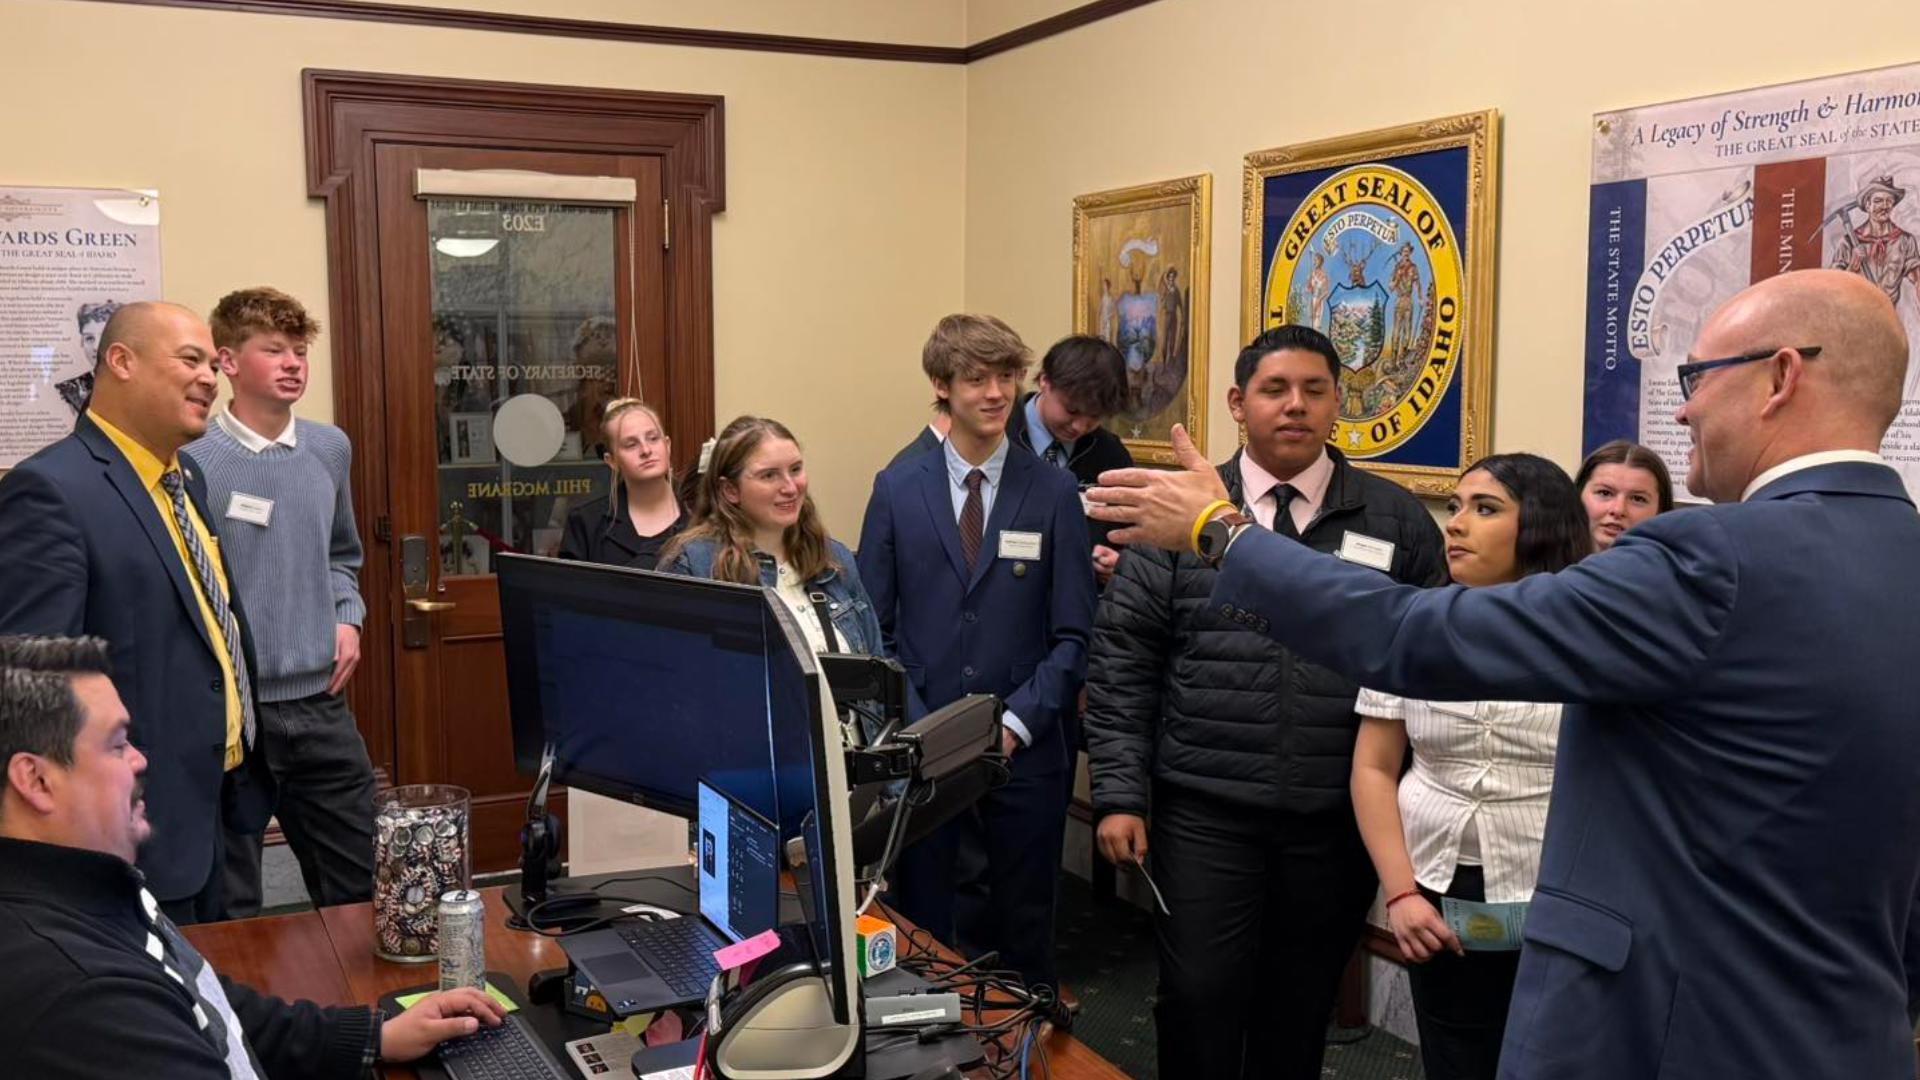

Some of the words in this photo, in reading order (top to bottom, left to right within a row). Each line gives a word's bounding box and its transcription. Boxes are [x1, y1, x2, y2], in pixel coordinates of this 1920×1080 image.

[1630, 126, 1645, 146] A
[1650, 123, 1705, 148] Legacy
[1711, 109, 1731, 141] of
[1732, 99, 1809, 133] Strength
[1817, 96, 1838, 119] &
[1715, 142, 1743, 157] THE
[1746, 135, 1797, 154] GREAT
[1800, 130, 1837, 147] SEAL
[1870, 119, 1920, 139] STATE
[1285, 182, 1348, 261] GREAT
[1356, 177, 1412, 214] SEAL
[1417, 210, 1445, 250] OF
[1348, 214, 1396, 243] PERPETUA
[1609, 206, 1622, 243] THE
[1780, 188, 1796, 230] THE
[2, 250, 19, 258] THE
[22, 249, 52, 258] GREAT
[55, 249, 77, 258] SEAL
[1607, 248, 1620, 301] STATE
[1778, 234, 1794, 273] MIN
[1605, 306, 1618, 370] MOTTO
[1632, 285, 1656, 350] ESTO
[1371, 411, 1402, 442] OF
[1407, 297, 1456, 417] IDAHO
